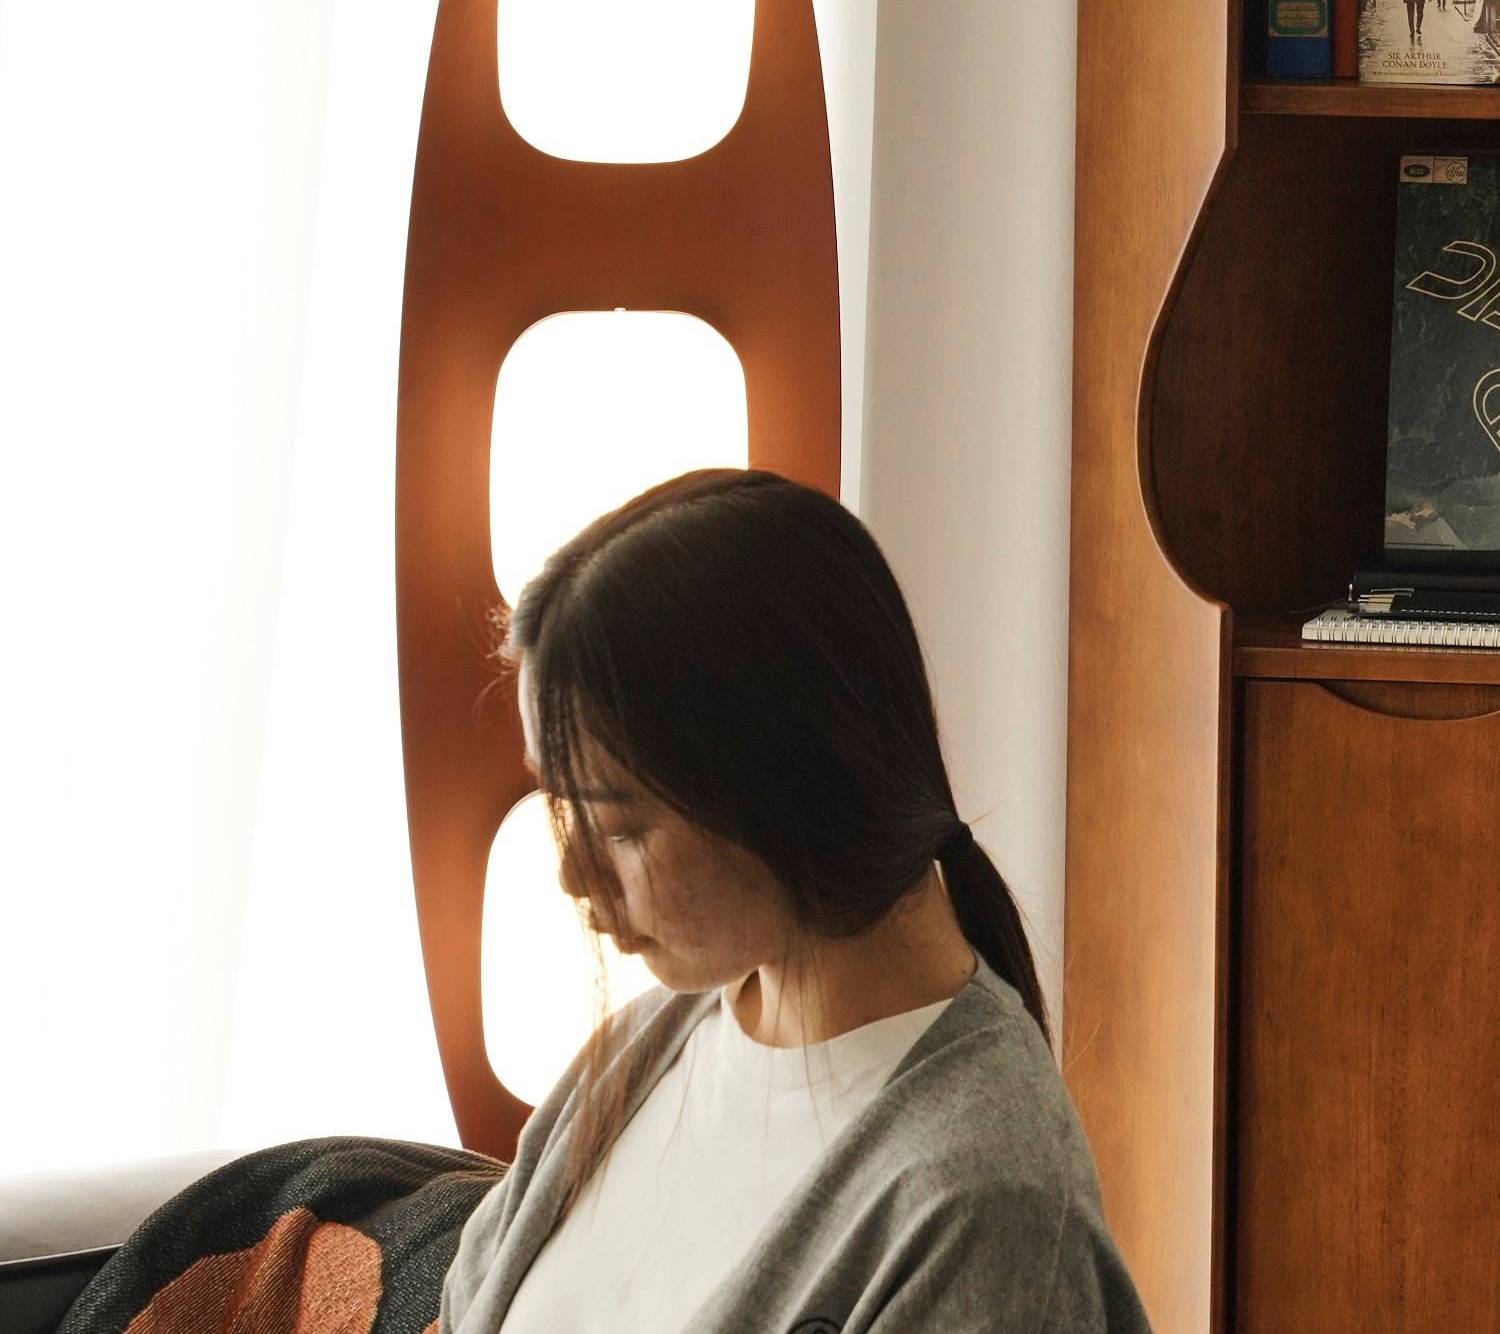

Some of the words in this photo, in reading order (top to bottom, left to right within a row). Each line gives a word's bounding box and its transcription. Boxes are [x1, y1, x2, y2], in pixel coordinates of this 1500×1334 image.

[1388, 52, 1401, 60] SIR
[1404, 52, 1442, 60] ARTHUR
[1382, 60, 1417, 69] CONAN
[1419, 61, 1447, 69] DOYLE
